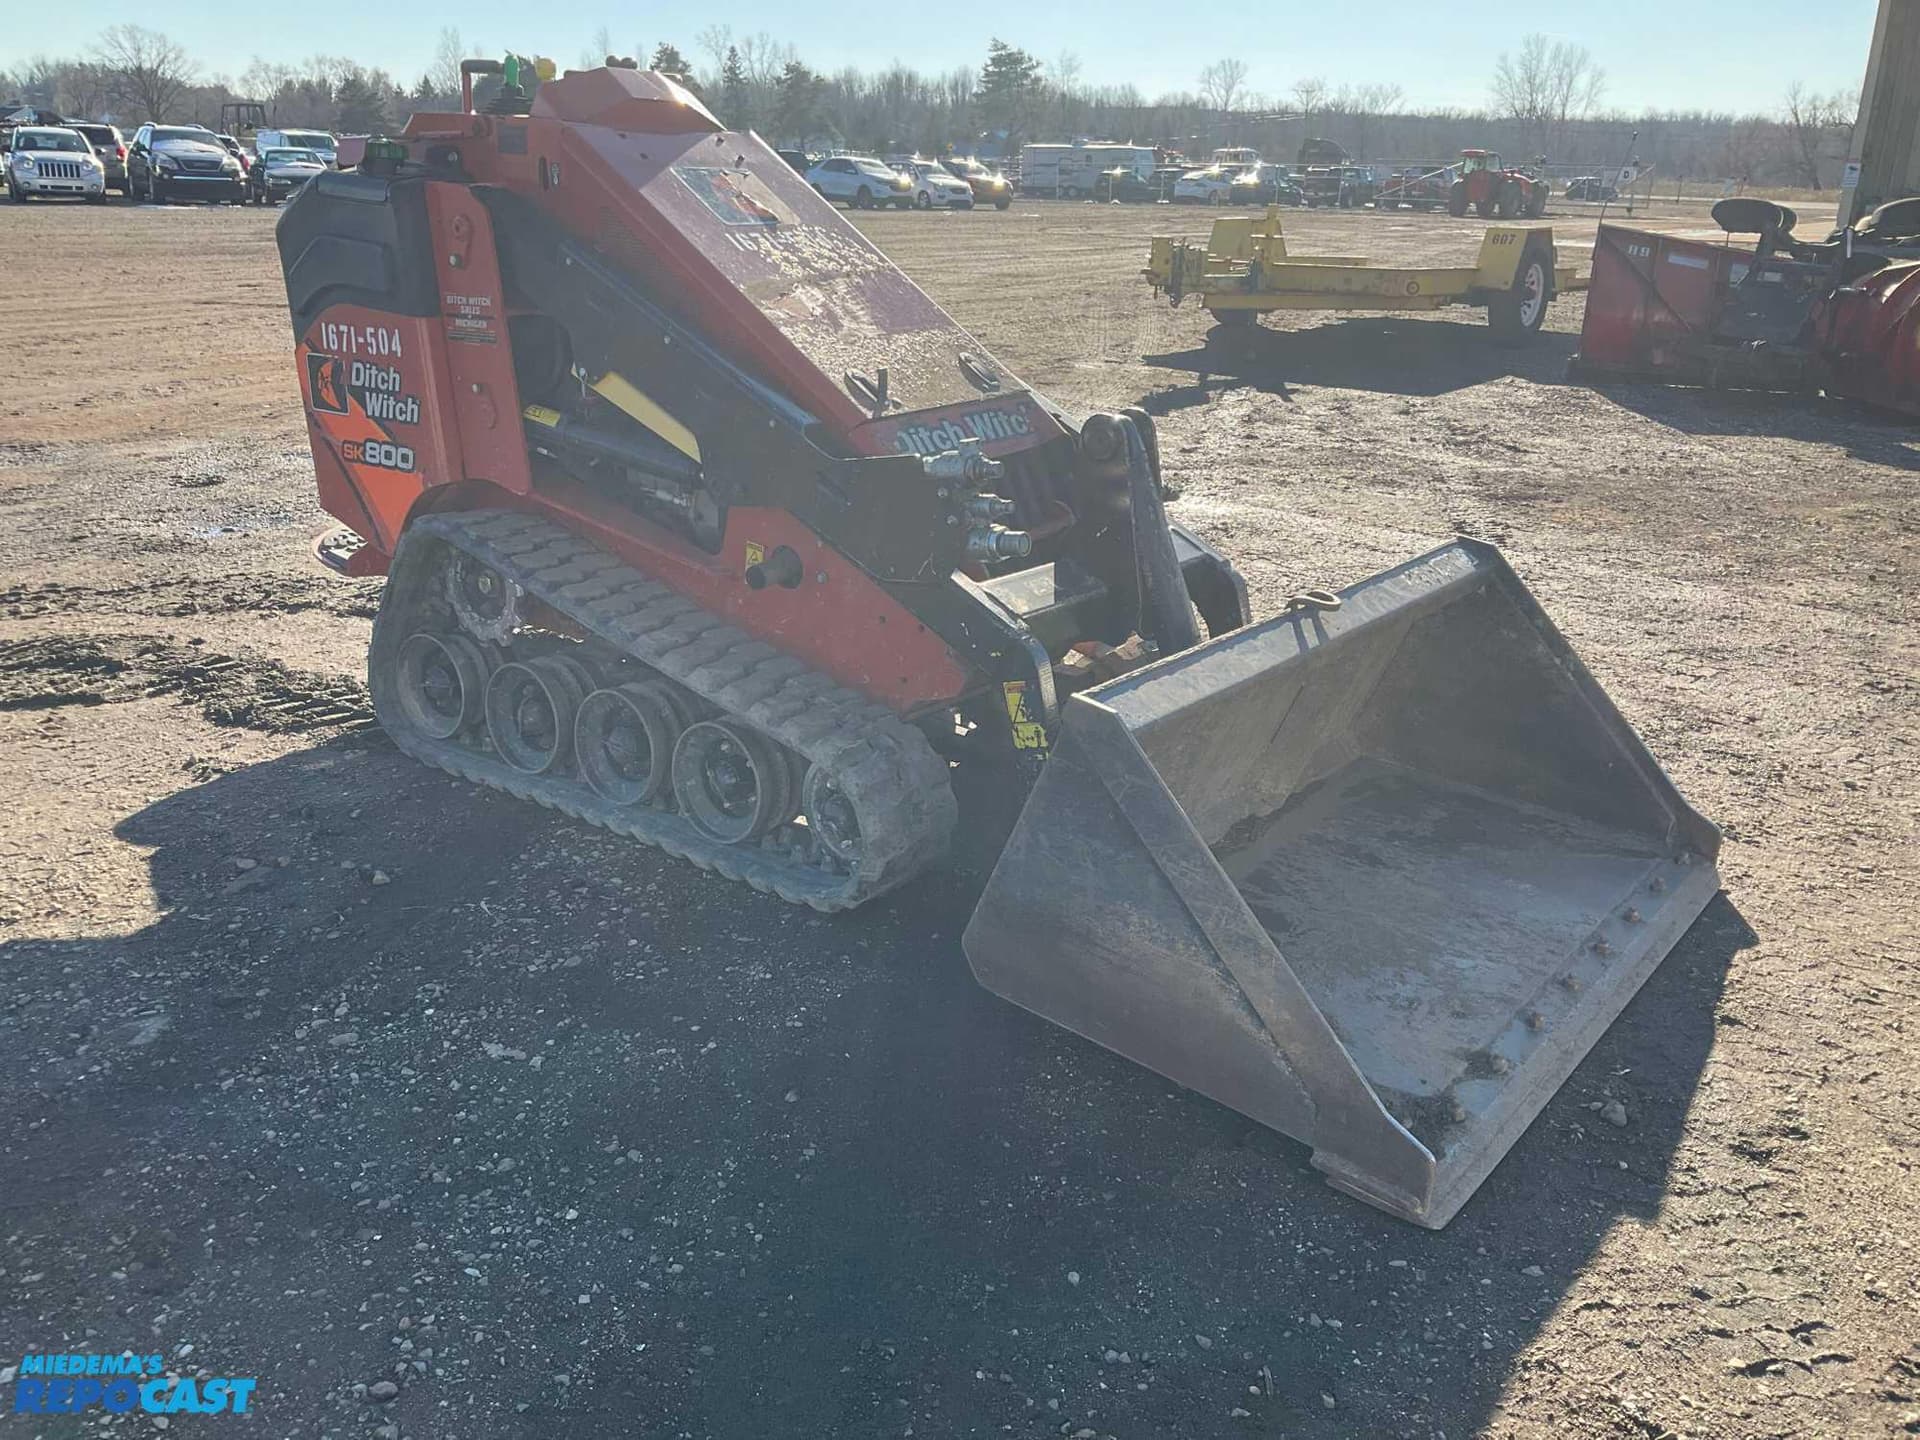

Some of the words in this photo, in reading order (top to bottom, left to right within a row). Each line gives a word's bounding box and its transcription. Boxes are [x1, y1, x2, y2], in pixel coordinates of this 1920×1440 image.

[1492, 233, 1516, 245] 607
[321, 322, 402, 357] 1671-504
[351, 361, 400, 391] Ditch
[365, 392, 419, 423] Witch
[963, 406, 1034, 441] Witc
[343, 441, 415, 470] SK800
